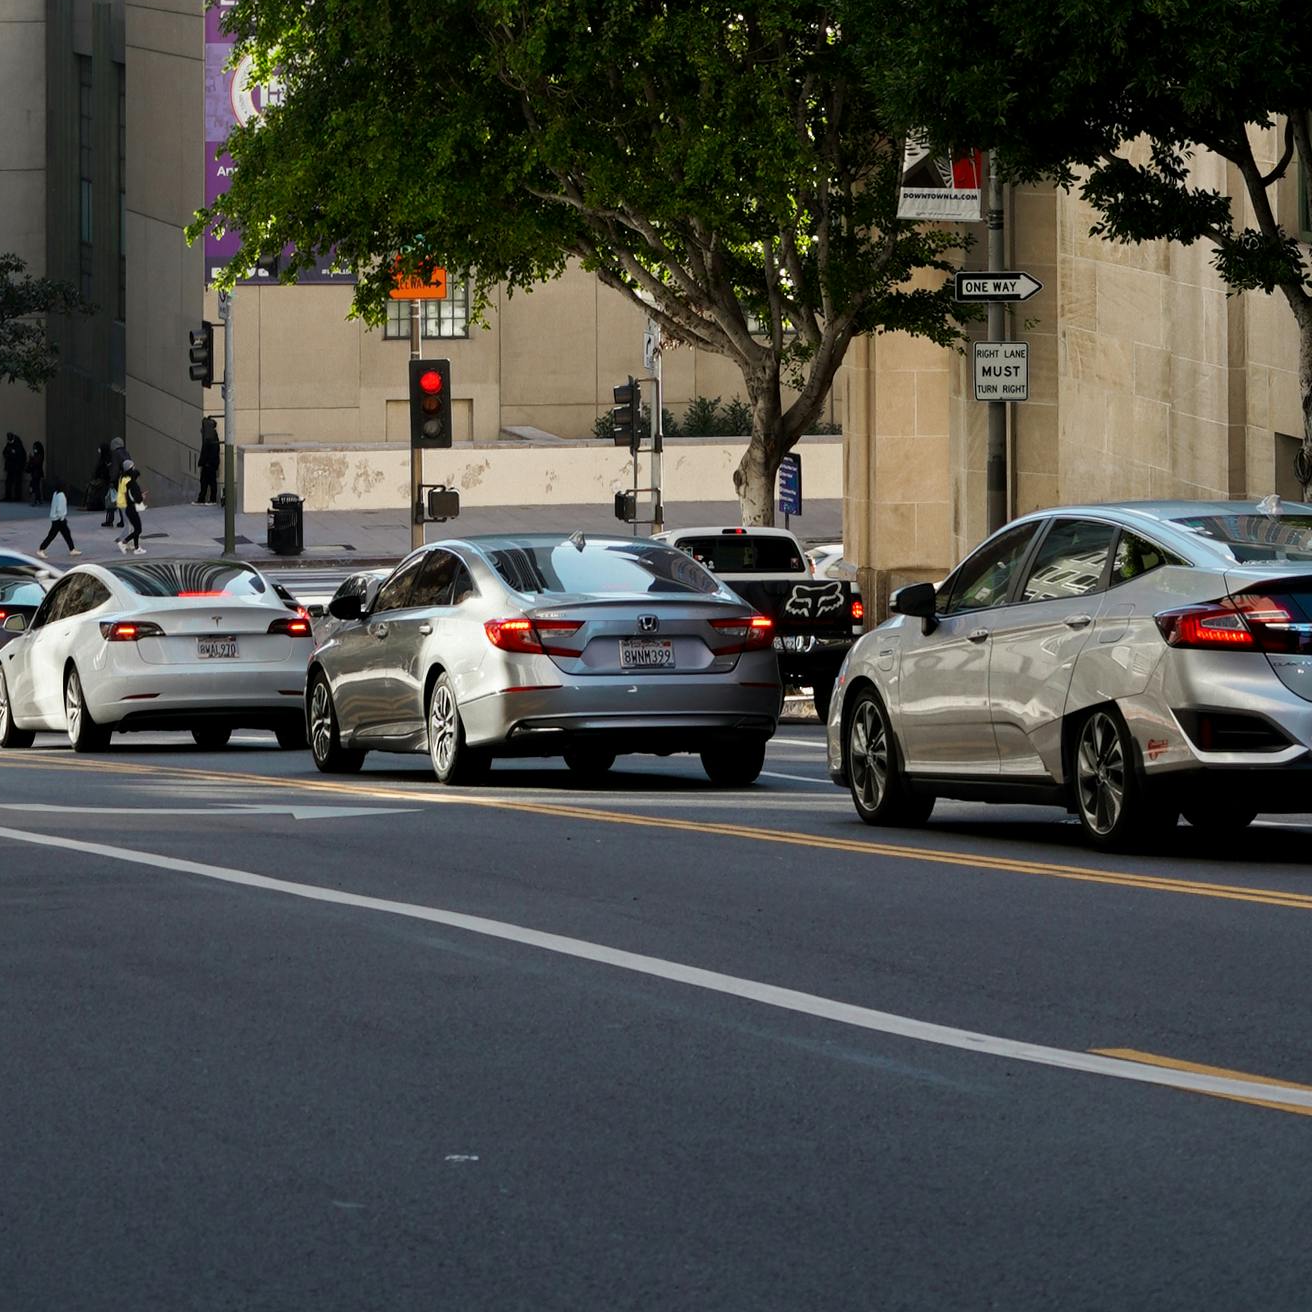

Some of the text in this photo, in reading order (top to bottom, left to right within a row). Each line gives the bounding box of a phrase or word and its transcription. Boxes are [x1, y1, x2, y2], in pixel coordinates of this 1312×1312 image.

[903, 193, 978, 201] DOWNTOWNLA.COM
[965, 282, 1017, 293] ONE WAY
[977, 350, 1025, 358] RIGHT LANE
[982, 366, 1020, 377] MUST
[977, 385, 1025, 394] TURN RIGHT
[624, 649, 671, 663] 8WNM399
